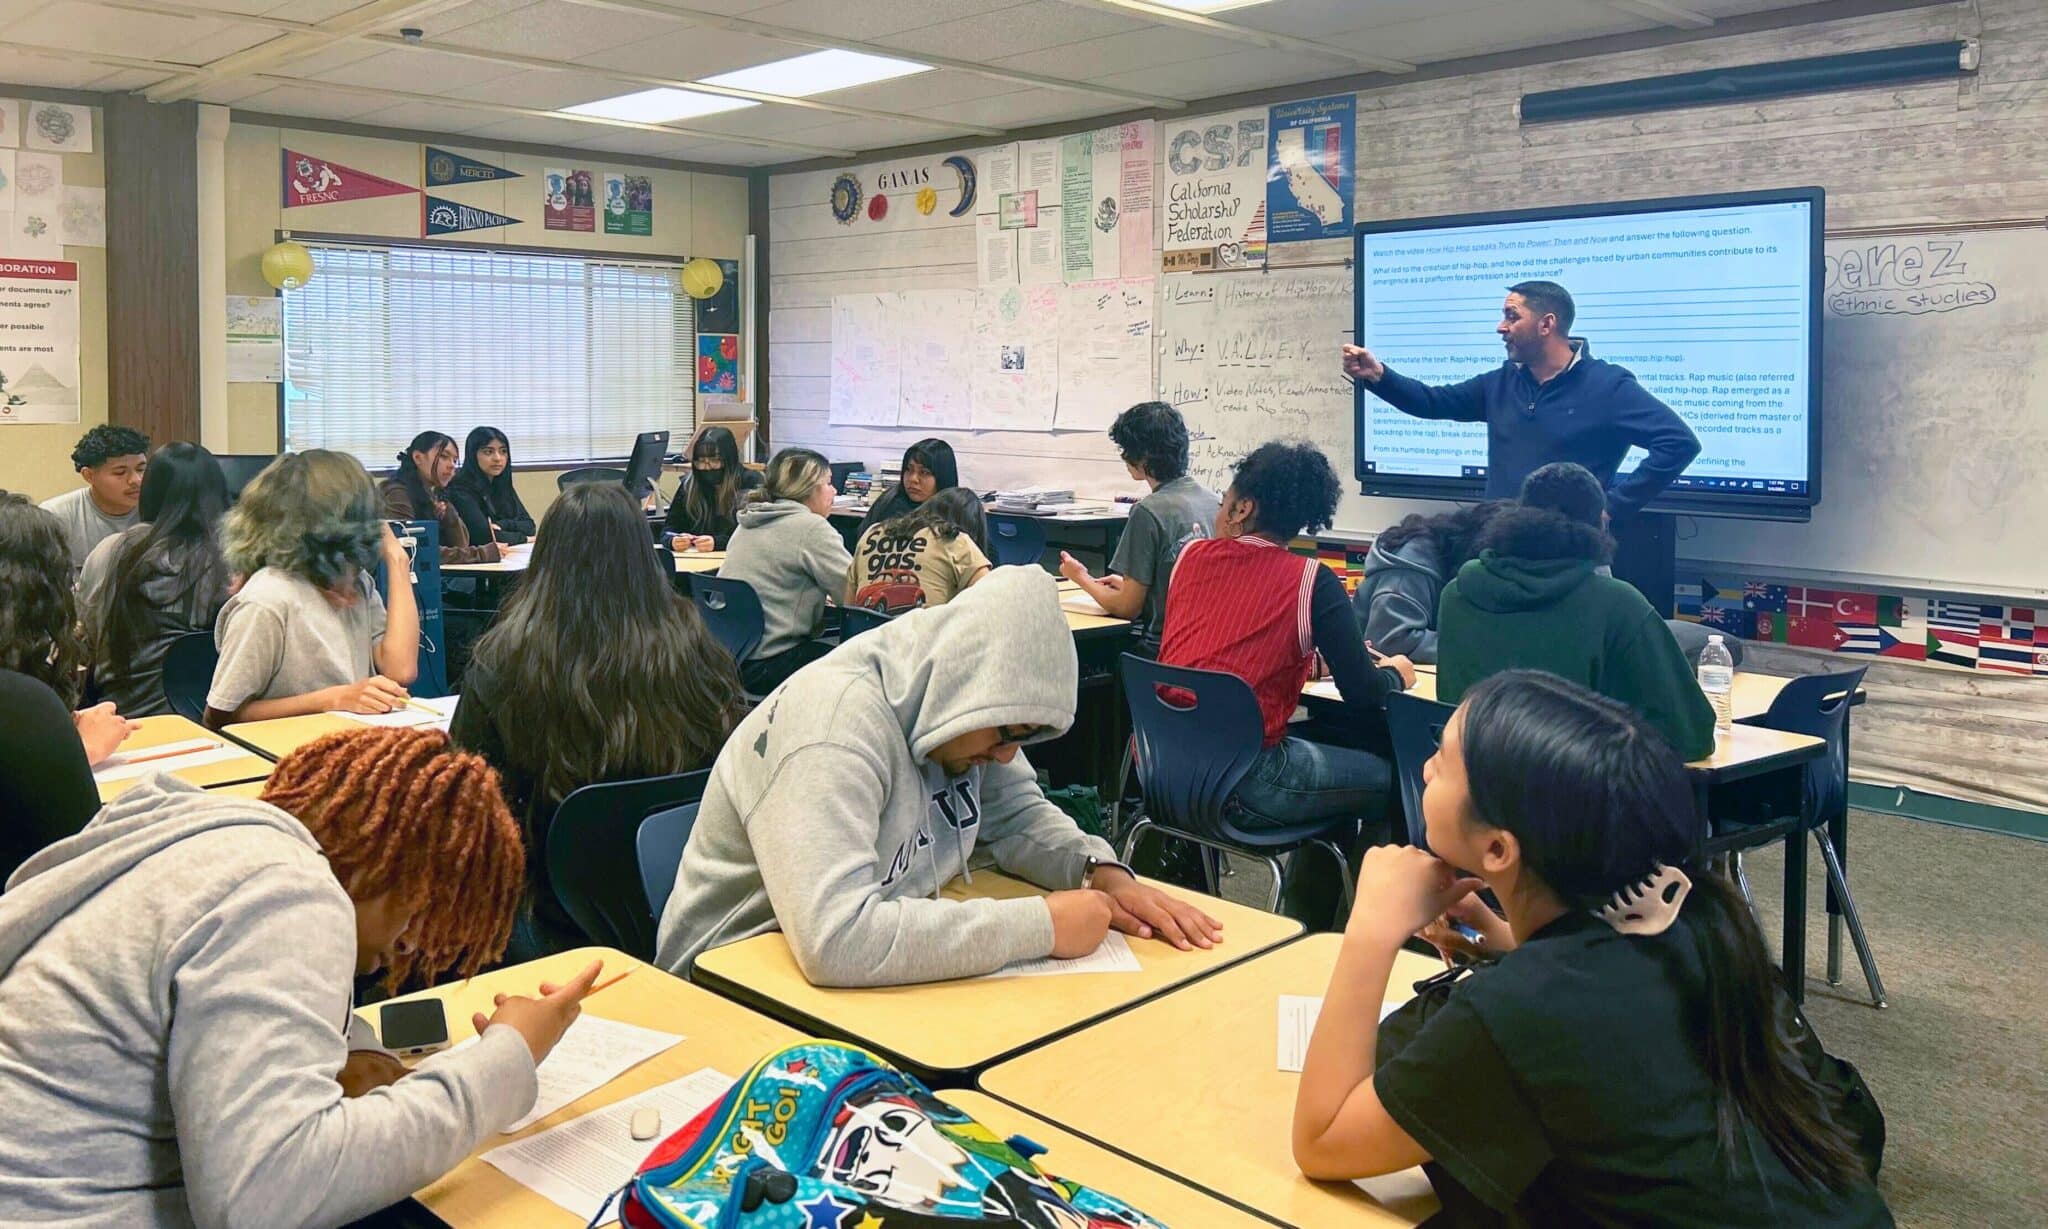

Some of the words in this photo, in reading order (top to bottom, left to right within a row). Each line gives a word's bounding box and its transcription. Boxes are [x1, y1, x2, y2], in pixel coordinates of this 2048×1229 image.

[1298, 116, 1331, 125] CALIFORNIA
[1168, 119, 1264, 176] CSF
[460, 167, 496, 178] MERCED
[878, 167, 929, 190] GANAS
[1170, 179, 1231, 202] California
[459, 206, 484, 230] FRESNO
[484, 212, 510, 227] PACIFIC
[1169, 198, 1241, 220] Scholarship
[1168, 222, 1232, 242] Federation
[1395, 248, 1406, 256] the
[1406, 248, 1424, 256] video
[1426, 247, 1442, 255] How
[1456, 245, 1470, 253] Hop
[1472, 244, 1496, 253] speaks
[1498, 241, 1516, 250] Truth
[1554, 238, 1572, 246] Then
[1574, 237, 1588, 245] and
[1590, 236, 1608, 244] Now
[1610, 234, 1624, 242] and
[1626, 233, 1655, 242] answer
[1657, 231, 1670, 240] the
[1672, 229, 1710, 239] following
[1712, 226, 1752, 237] question.
[1373, 266, 1390, 275] What
[1391, 266, 1402, 274] led
[1410, 265, 1421, 273] the
[1422, 264, 1450, 272] creation
[1452, 262, 1459, 270] of
[1491, 260, 1505, 268] and
[1506, 259, 1521, 267] how
[1522, 258, 1534, 266] did
[1536, 258, 1548, 266] the
[1549, 254, 1590, 265] challenges
[1592, 254, 1614, 262] faced
[1616, 253, 1625, 263] by
[1626, 252, 1650, 260] urban
[1652, 249, 1706, 260] communities
[1708, 246, 1753, 256] contribute
[1755, 246, 1764, 254] to
[1766, 245, 1778, 254] its
[1373, 278, 1408, 286] emergence
[1424, 274, 1454, 284] platform
[1454, 274, 1464, 282] for
[1466, 272, 1504, 282] expression
[1505, 270, 1519, 278] and
[1520, 268, 1563, 279] resistance?
[8, 286, 52, 294] documents
[54, 288, 72, 296] say?
[1176, 281, 1214, 300] Learn:
[1224, 283, 1262, 304] History
[1832, 296, 1896, 312] ethnic
[1907, 288, 1990, 307] studies
[24, 302, 50, 310] agree?
[10, 323, 44, 331] possible
[1174, 338, 1204, 364] Why:
[1419, 374, 1440, 382] poetry
[1659, 374, 1685, 382] tracks.
[1688, 373, 1706, 383] Rap
[1707, 374, 1734, 382] music
[1736, 373, 1757, 382] (also
[1759, 373, 1795, 382] referred
[1174, 382, 1208, 403] How:
[1216, 379, 1243, 396] Video
[1648, 386, 1673, 394] called
[1675, 386, 1709, 396] hip-hop.
[1712, 386, 1729, 396] Rap
[1731, 387, 1770, 396] emerged
[1216, 402, 1248, 414] Create
[1280, 402, 1310, 424] Song
[1684, 400, 1710, 408] music
[1712, 400, 1744, 410] coming
[1746, 400, 1766, 408] from
[1768, 400, 1783, 408] the
[1700, 412, 1735, 422] (derived
[1736, 412, 1758, 421] from
[1759, 414, 1791, 422] master
[1792, 414, 1802, 422] of
[1373, 430, 1403, 438] backdrop
[1694, 425, 1732, 434] recorded
[1735, 426, 1761, 434] tracks
[1400, 446, 1425, 454] humble
[1426, 448, 1462, 456] beginnings
[1464, 448, 1470, 456] in
[1696, 458, 1730, 468] defining
[1732, 458, 1746, 467] the
[862, 530, 927, 556] Save
[868, 552, 922, 580] gas.
[765, 1087, 801, 1146] GO!
